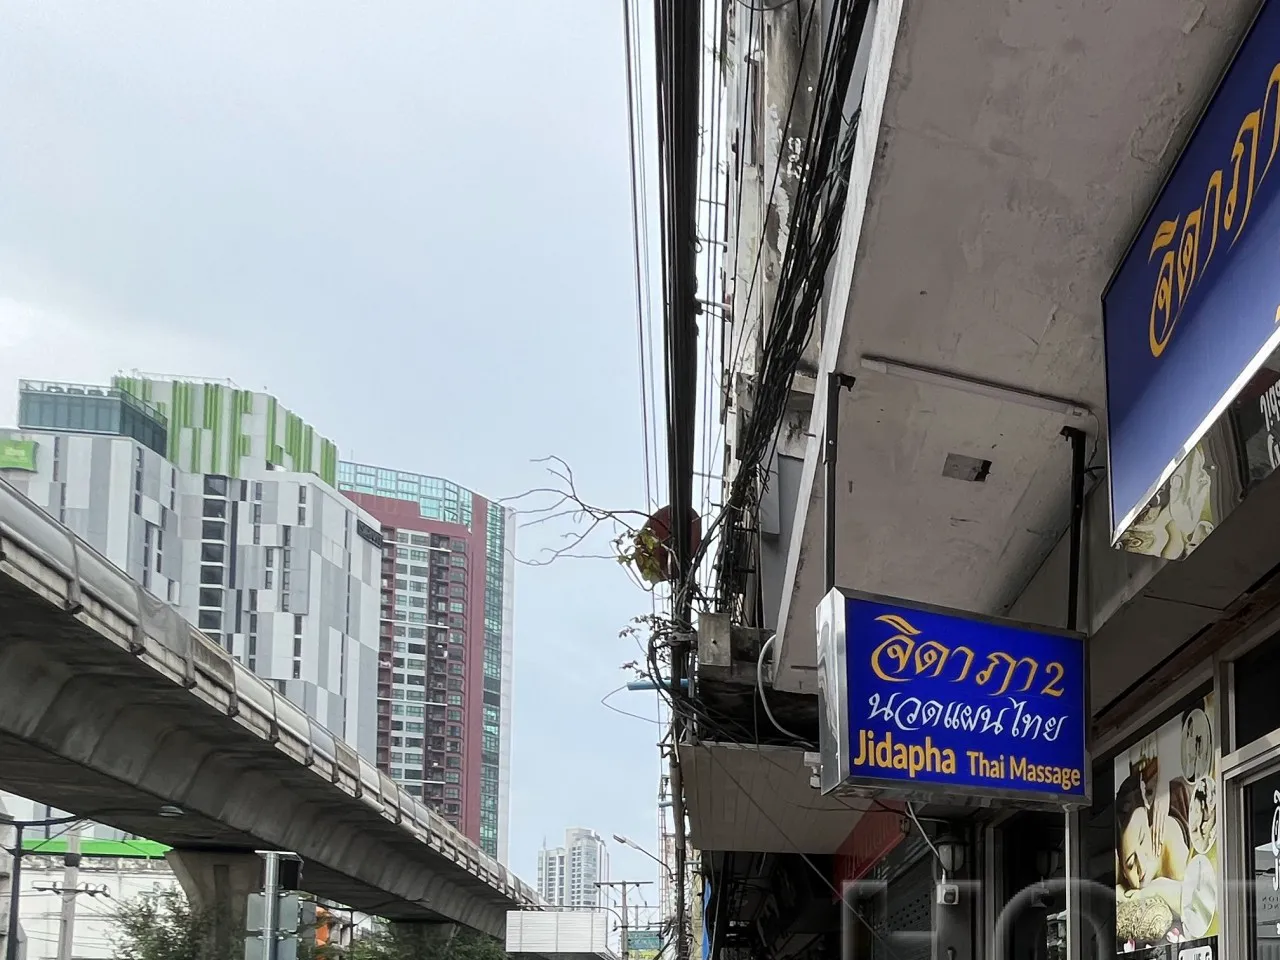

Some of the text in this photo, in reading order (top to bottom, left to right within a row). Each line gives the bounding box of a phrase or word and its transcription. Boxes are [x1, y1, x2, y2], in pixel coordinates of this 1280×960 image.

[868, 692, 1068, 741] นวดแผนไทย
[854, 730, 1081, 790] Jidapha Thai Massage
